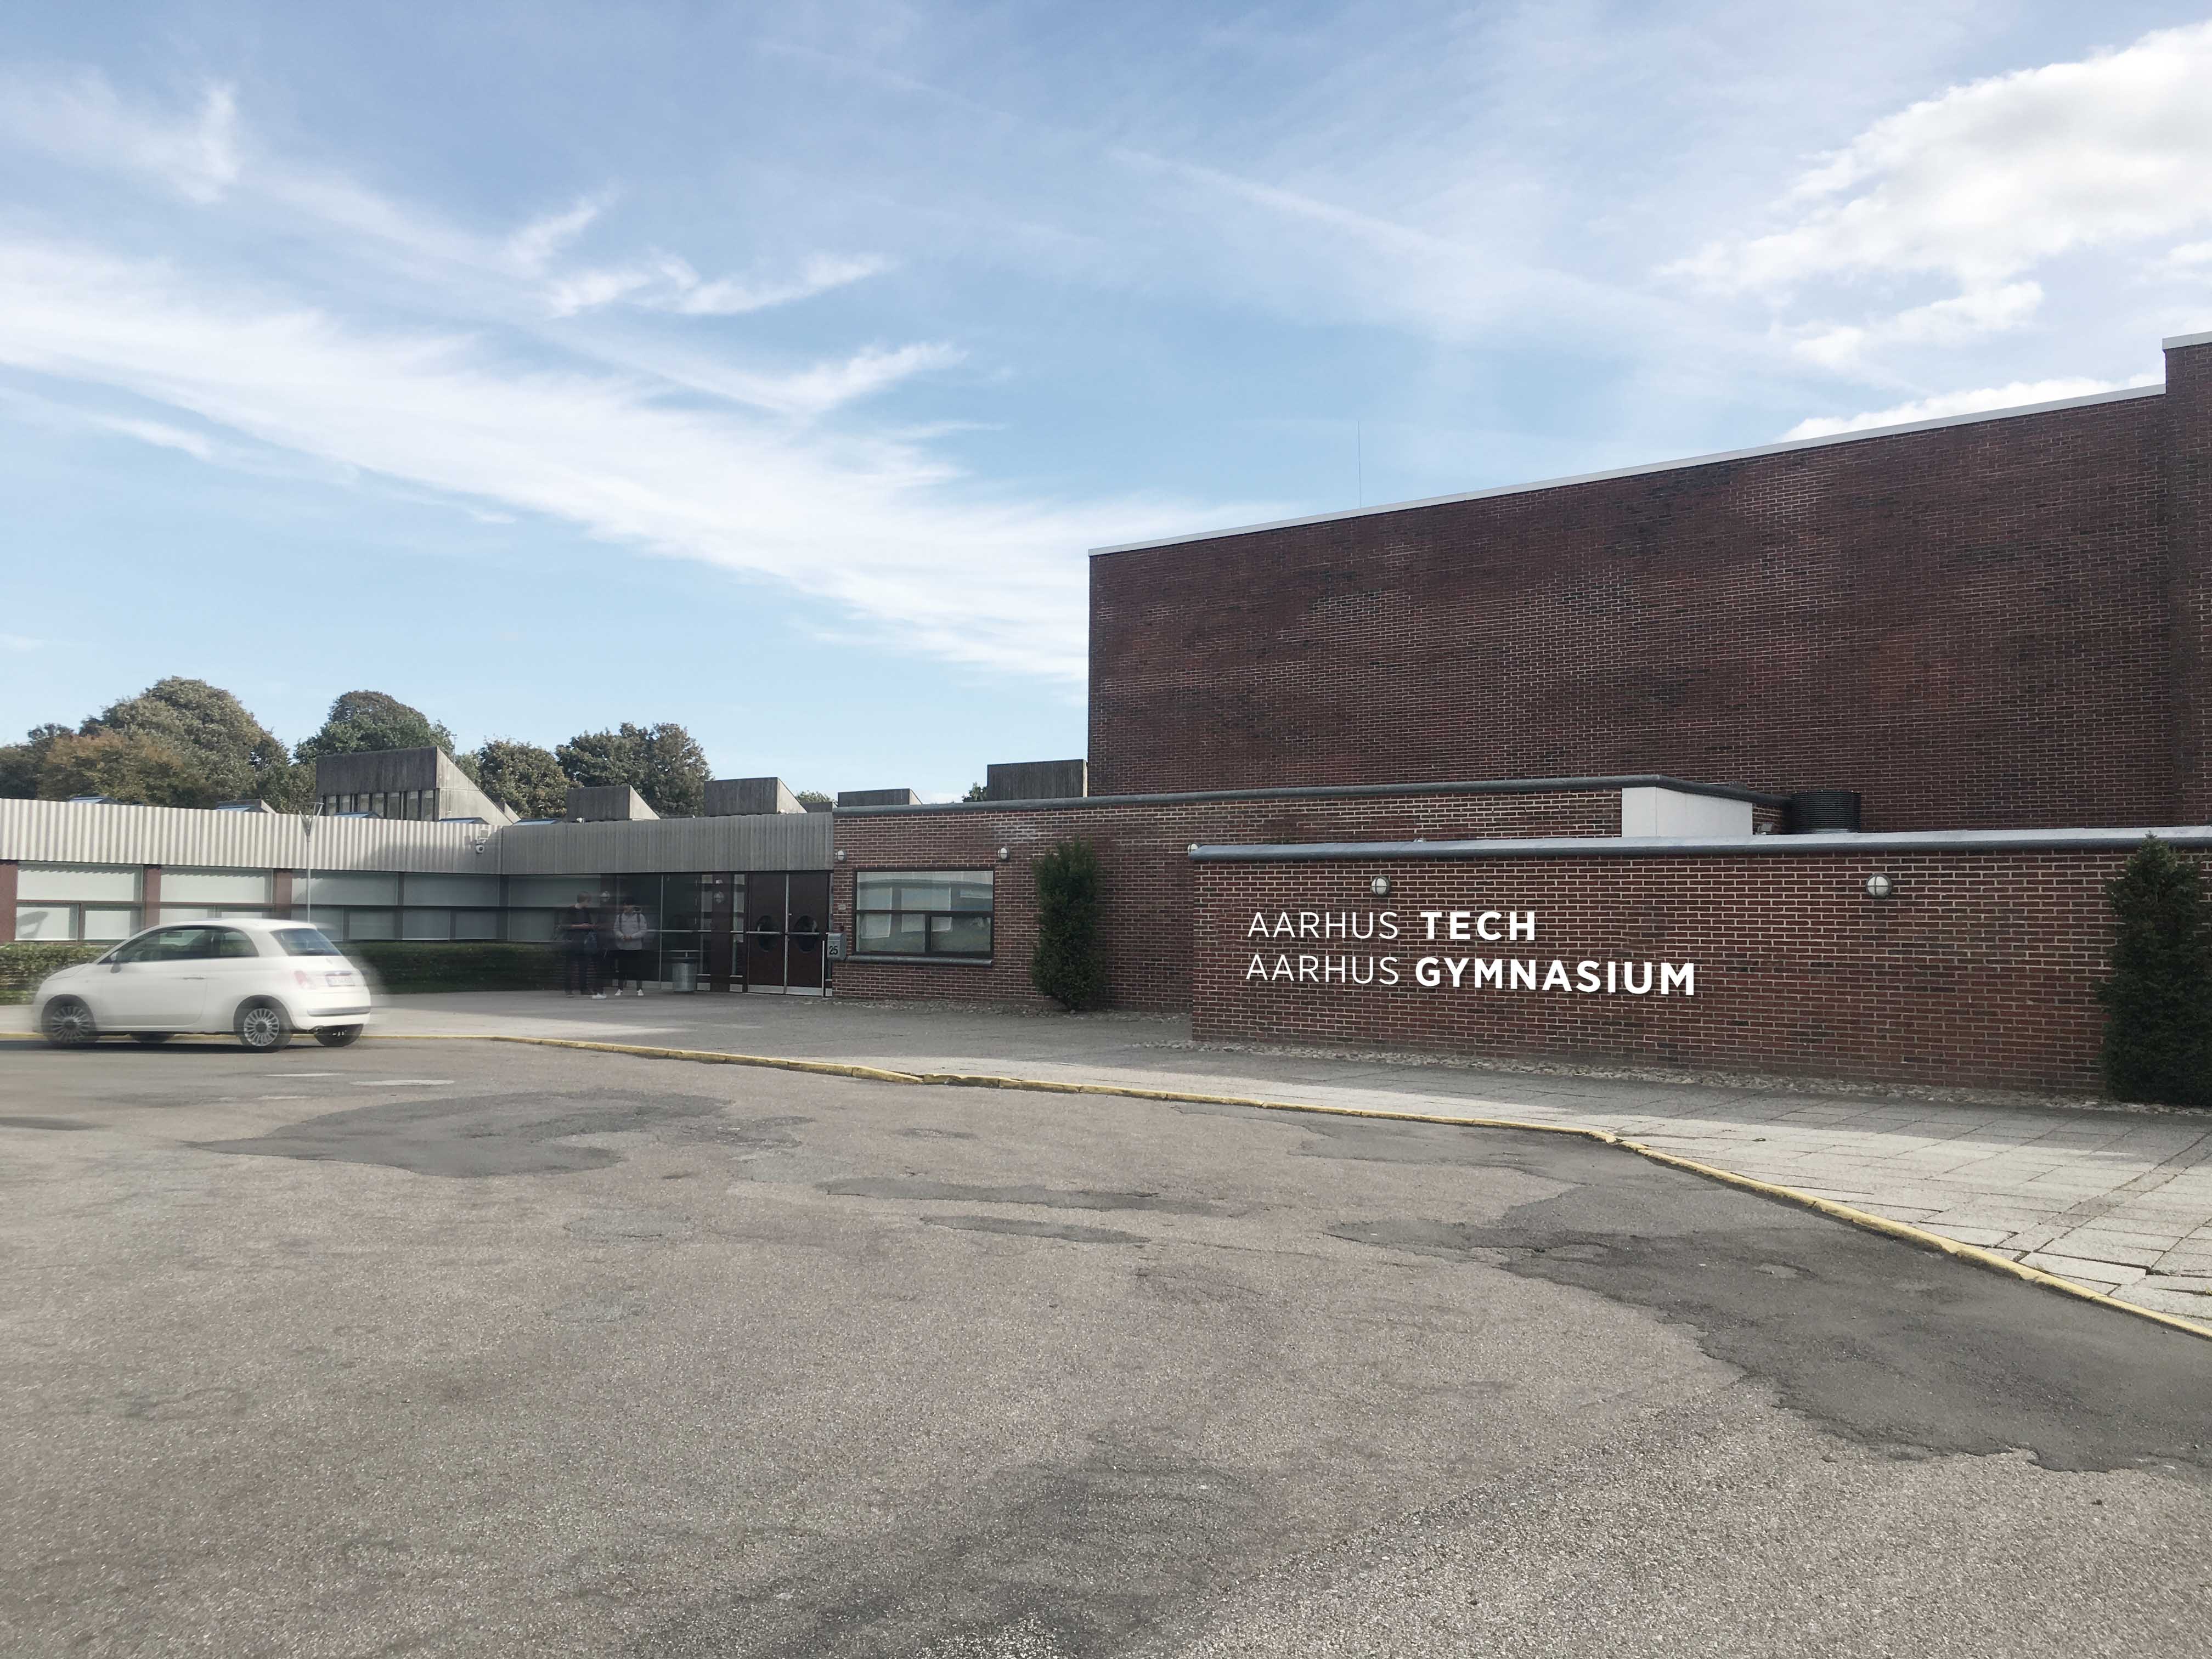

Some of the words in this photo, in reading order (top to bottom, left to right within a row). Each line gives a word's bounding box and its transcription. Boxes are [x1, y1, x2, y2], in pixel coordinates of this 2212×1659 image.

[1248, 911, 1398, 940] AARHUS
[1420, 911, 1536, 940] TECH
[829, 945, 838, 955] 25
[1246, 954, 1399, 985] AARHUS
[1415, 957, 1695, 996] GYMNASIUM
